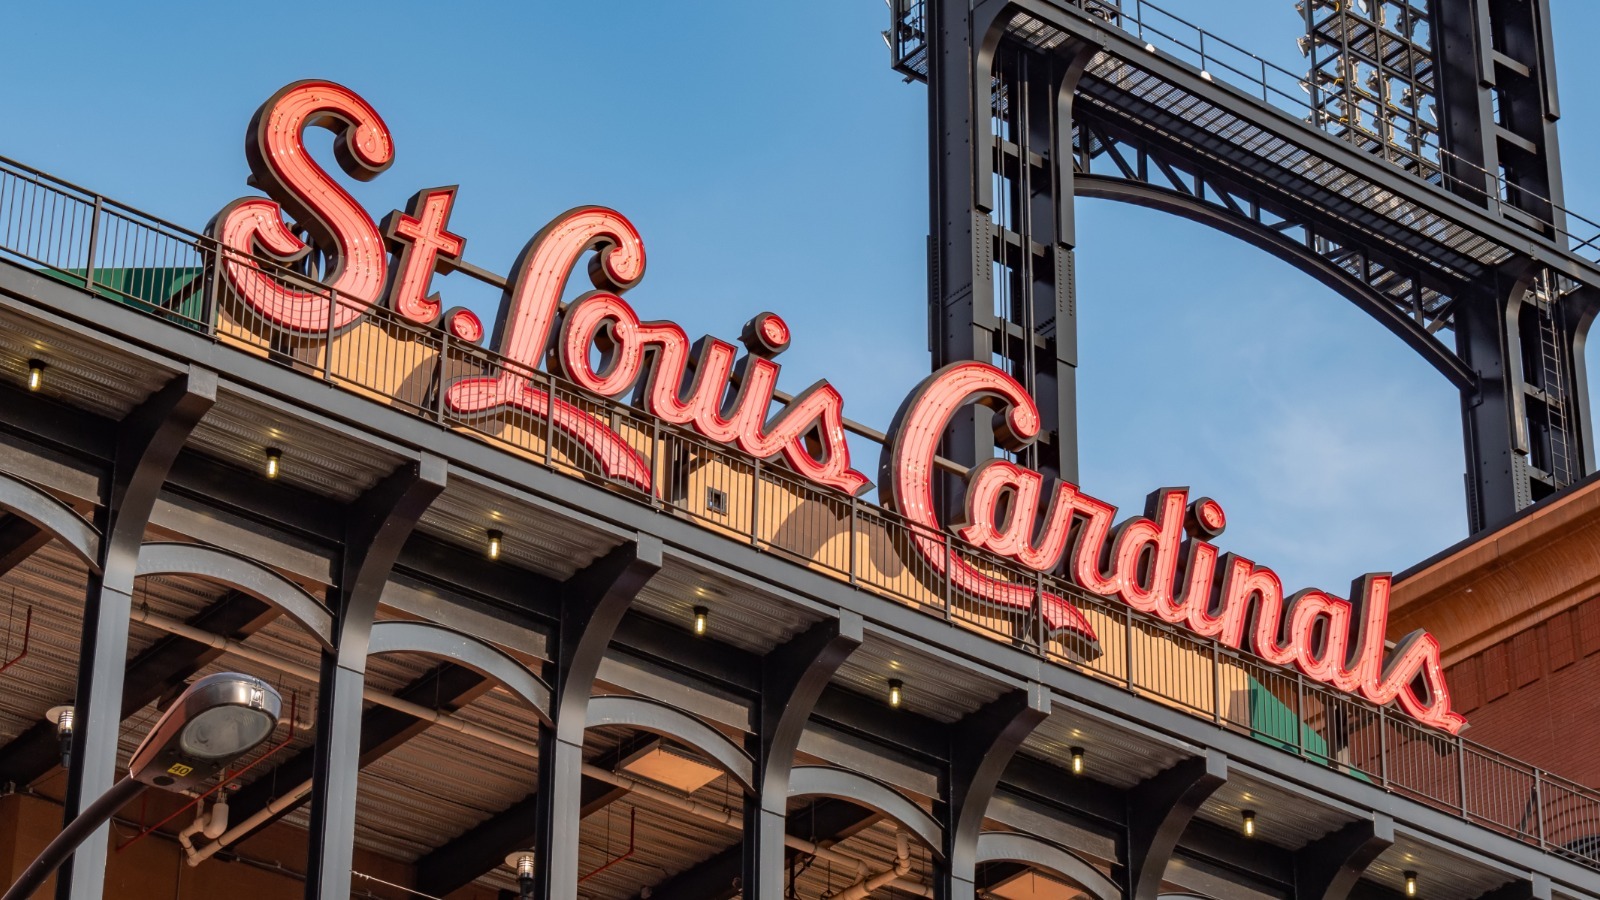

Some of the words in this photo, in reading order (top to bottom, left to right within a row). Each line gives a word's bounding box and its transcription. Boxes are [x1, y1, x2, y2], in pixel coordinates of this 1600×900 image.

[215, 80, 486, 343] St.
[446, 205, 875, 494] Louis
[892, 360, 1468, 735] Cardinals
[171, 765, 190, 775] 40
